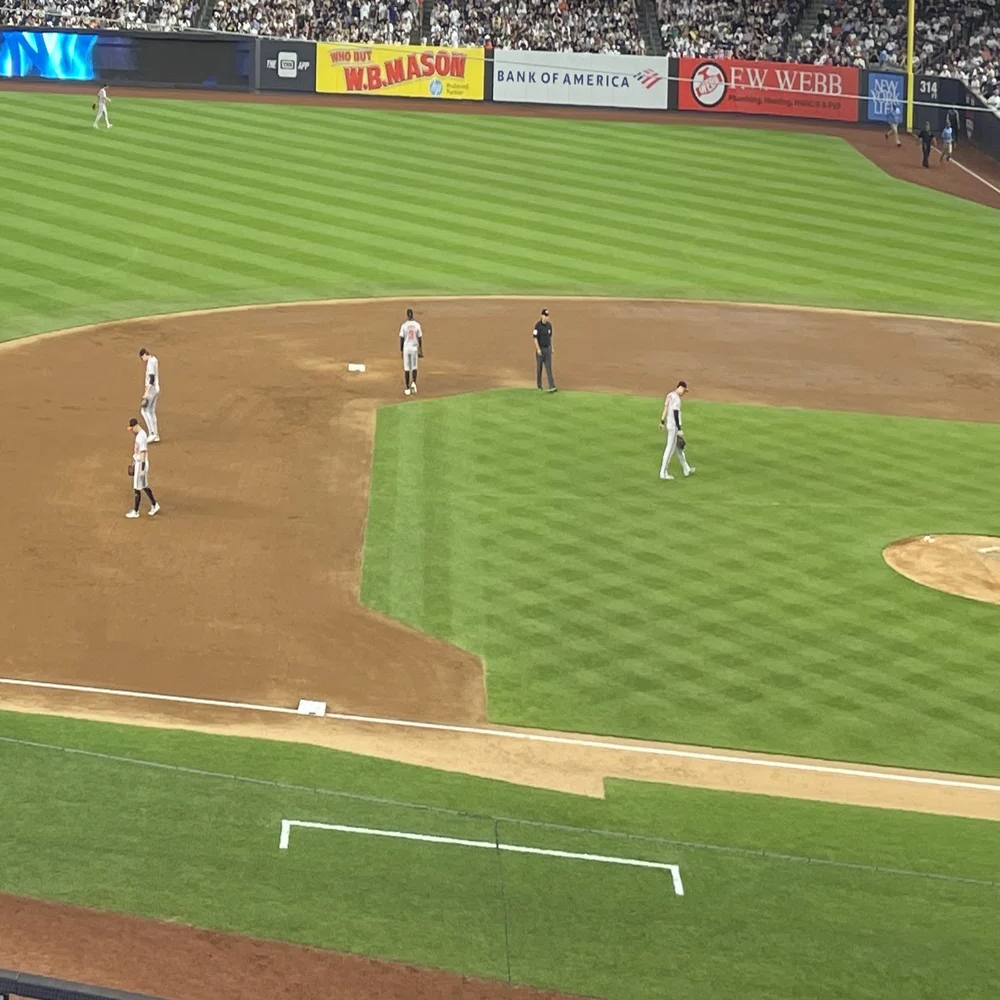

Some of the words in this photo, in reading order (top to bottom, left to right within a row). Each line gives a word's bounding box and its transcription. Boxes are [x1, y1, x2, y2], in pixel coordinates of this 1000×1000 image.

[330, 51, 350, 63] WHO
[353, 50, 372, 62] BUT
[497, 70, 536, 83] BANK
[540, 71, 559, 84] OF
[562, 73, 630, 88] AMERICA
[775, 70, 843, 96] WEBB
[874, 79, 899, 91] NEW
[919, 80, 938, 93] 314
